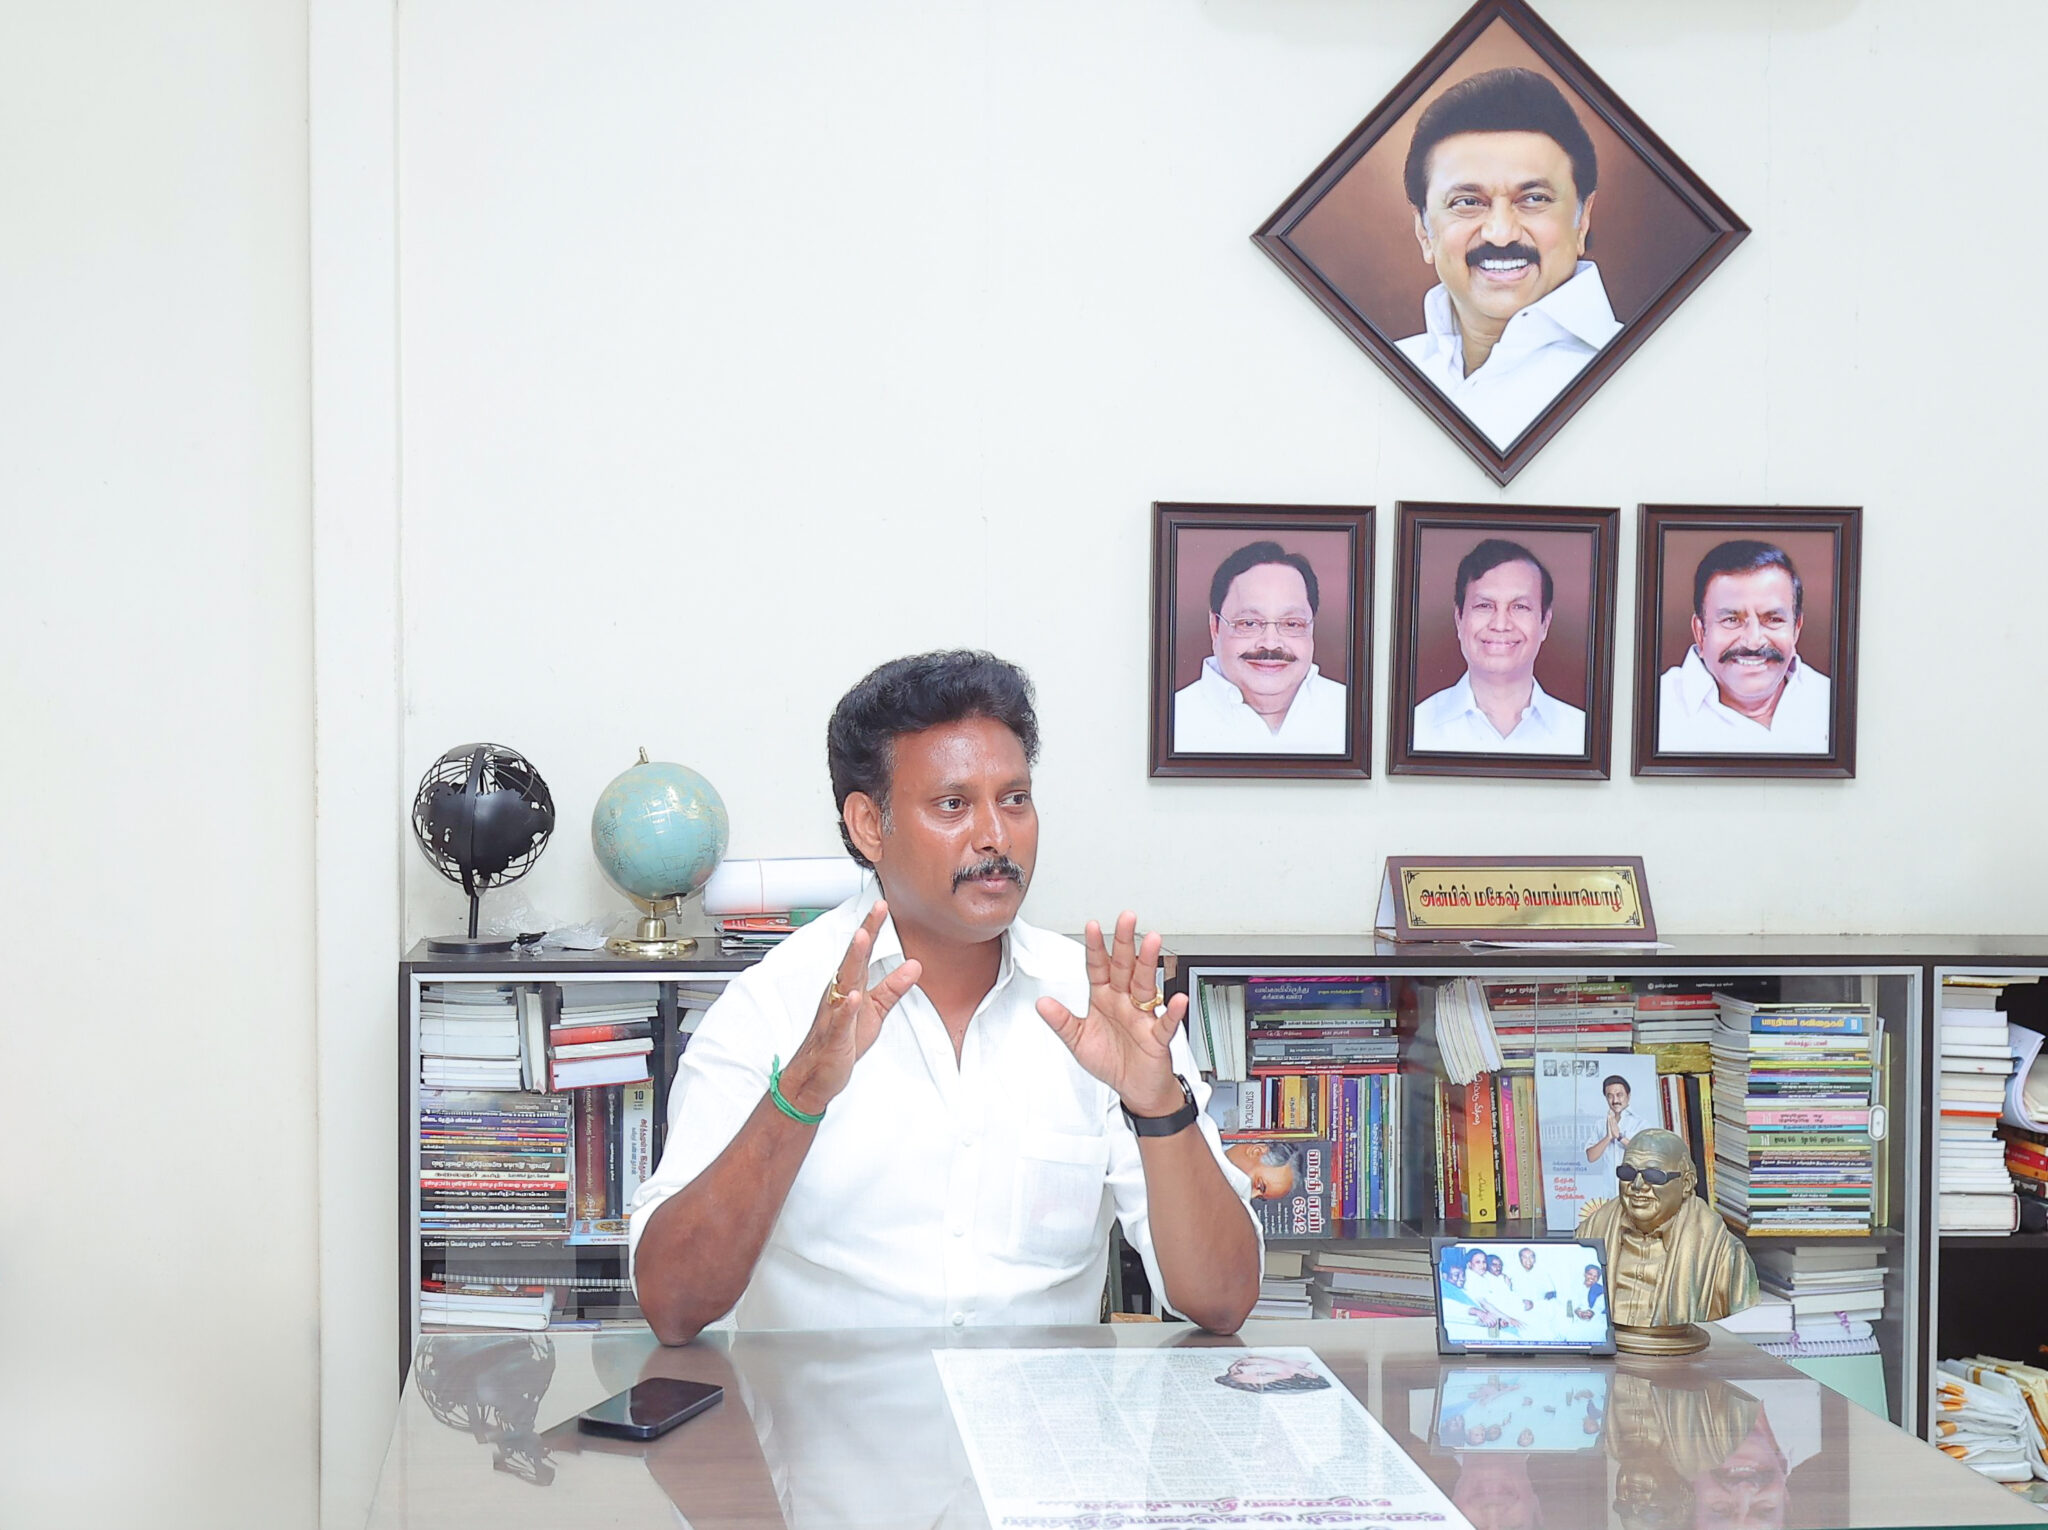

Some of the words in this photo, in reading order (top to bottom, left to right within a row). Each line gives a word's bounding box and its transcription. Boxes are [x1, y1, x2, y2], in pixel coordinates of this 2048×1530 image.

[1420, 885, 1471, 907] அன்பில்
[1475, 884, 1520, 911] மகேஷ்
[1523, 883, 1623, 912] பொய்யாமொழி
[1762, 1017, 1798, 1027] பாரதியார்
[1800, 1018, 1845, 1028] கவிதைகள்
[634, 1090, 644, 1100] 10
[1245, 1091, 1254, 1125] STATISTICAL
[640, 1118, 648, 1153] அர்த்தமுள்ள
[639, 1155, 648, 1183] இந்துமத
[1304, 1149, 1323, 1194] கைதி
[1293, 1197, 1306, 1234] 6342
[1308, 1196, 1325, 1233] எண்
